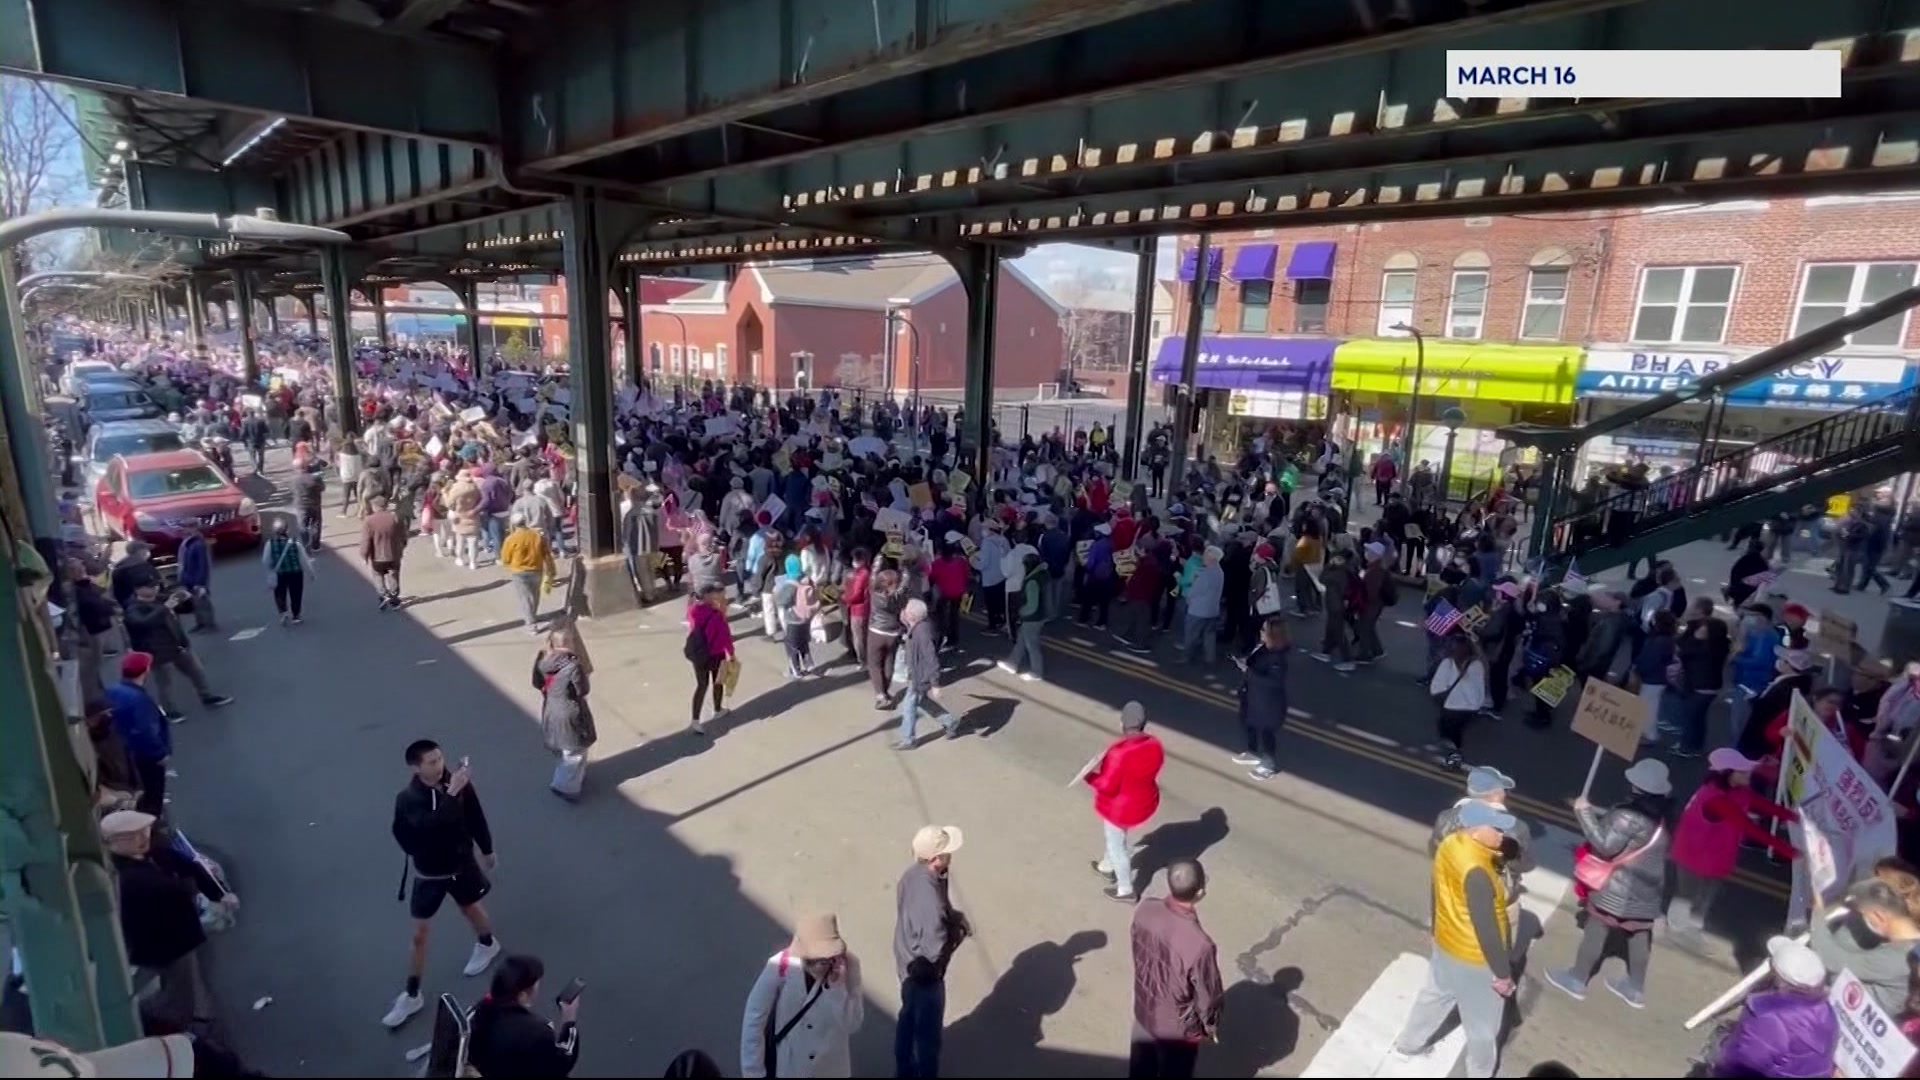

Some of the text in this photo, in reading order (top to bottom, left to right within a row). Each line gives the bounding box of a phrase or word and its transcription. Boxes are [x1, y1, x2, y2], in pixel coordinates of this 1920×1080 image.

[1630, 352, 1844, 380] PHARCY
[1598, 373, 1694, 392] АПТЕ
[1861, 1003, 1888, 1038] NO
